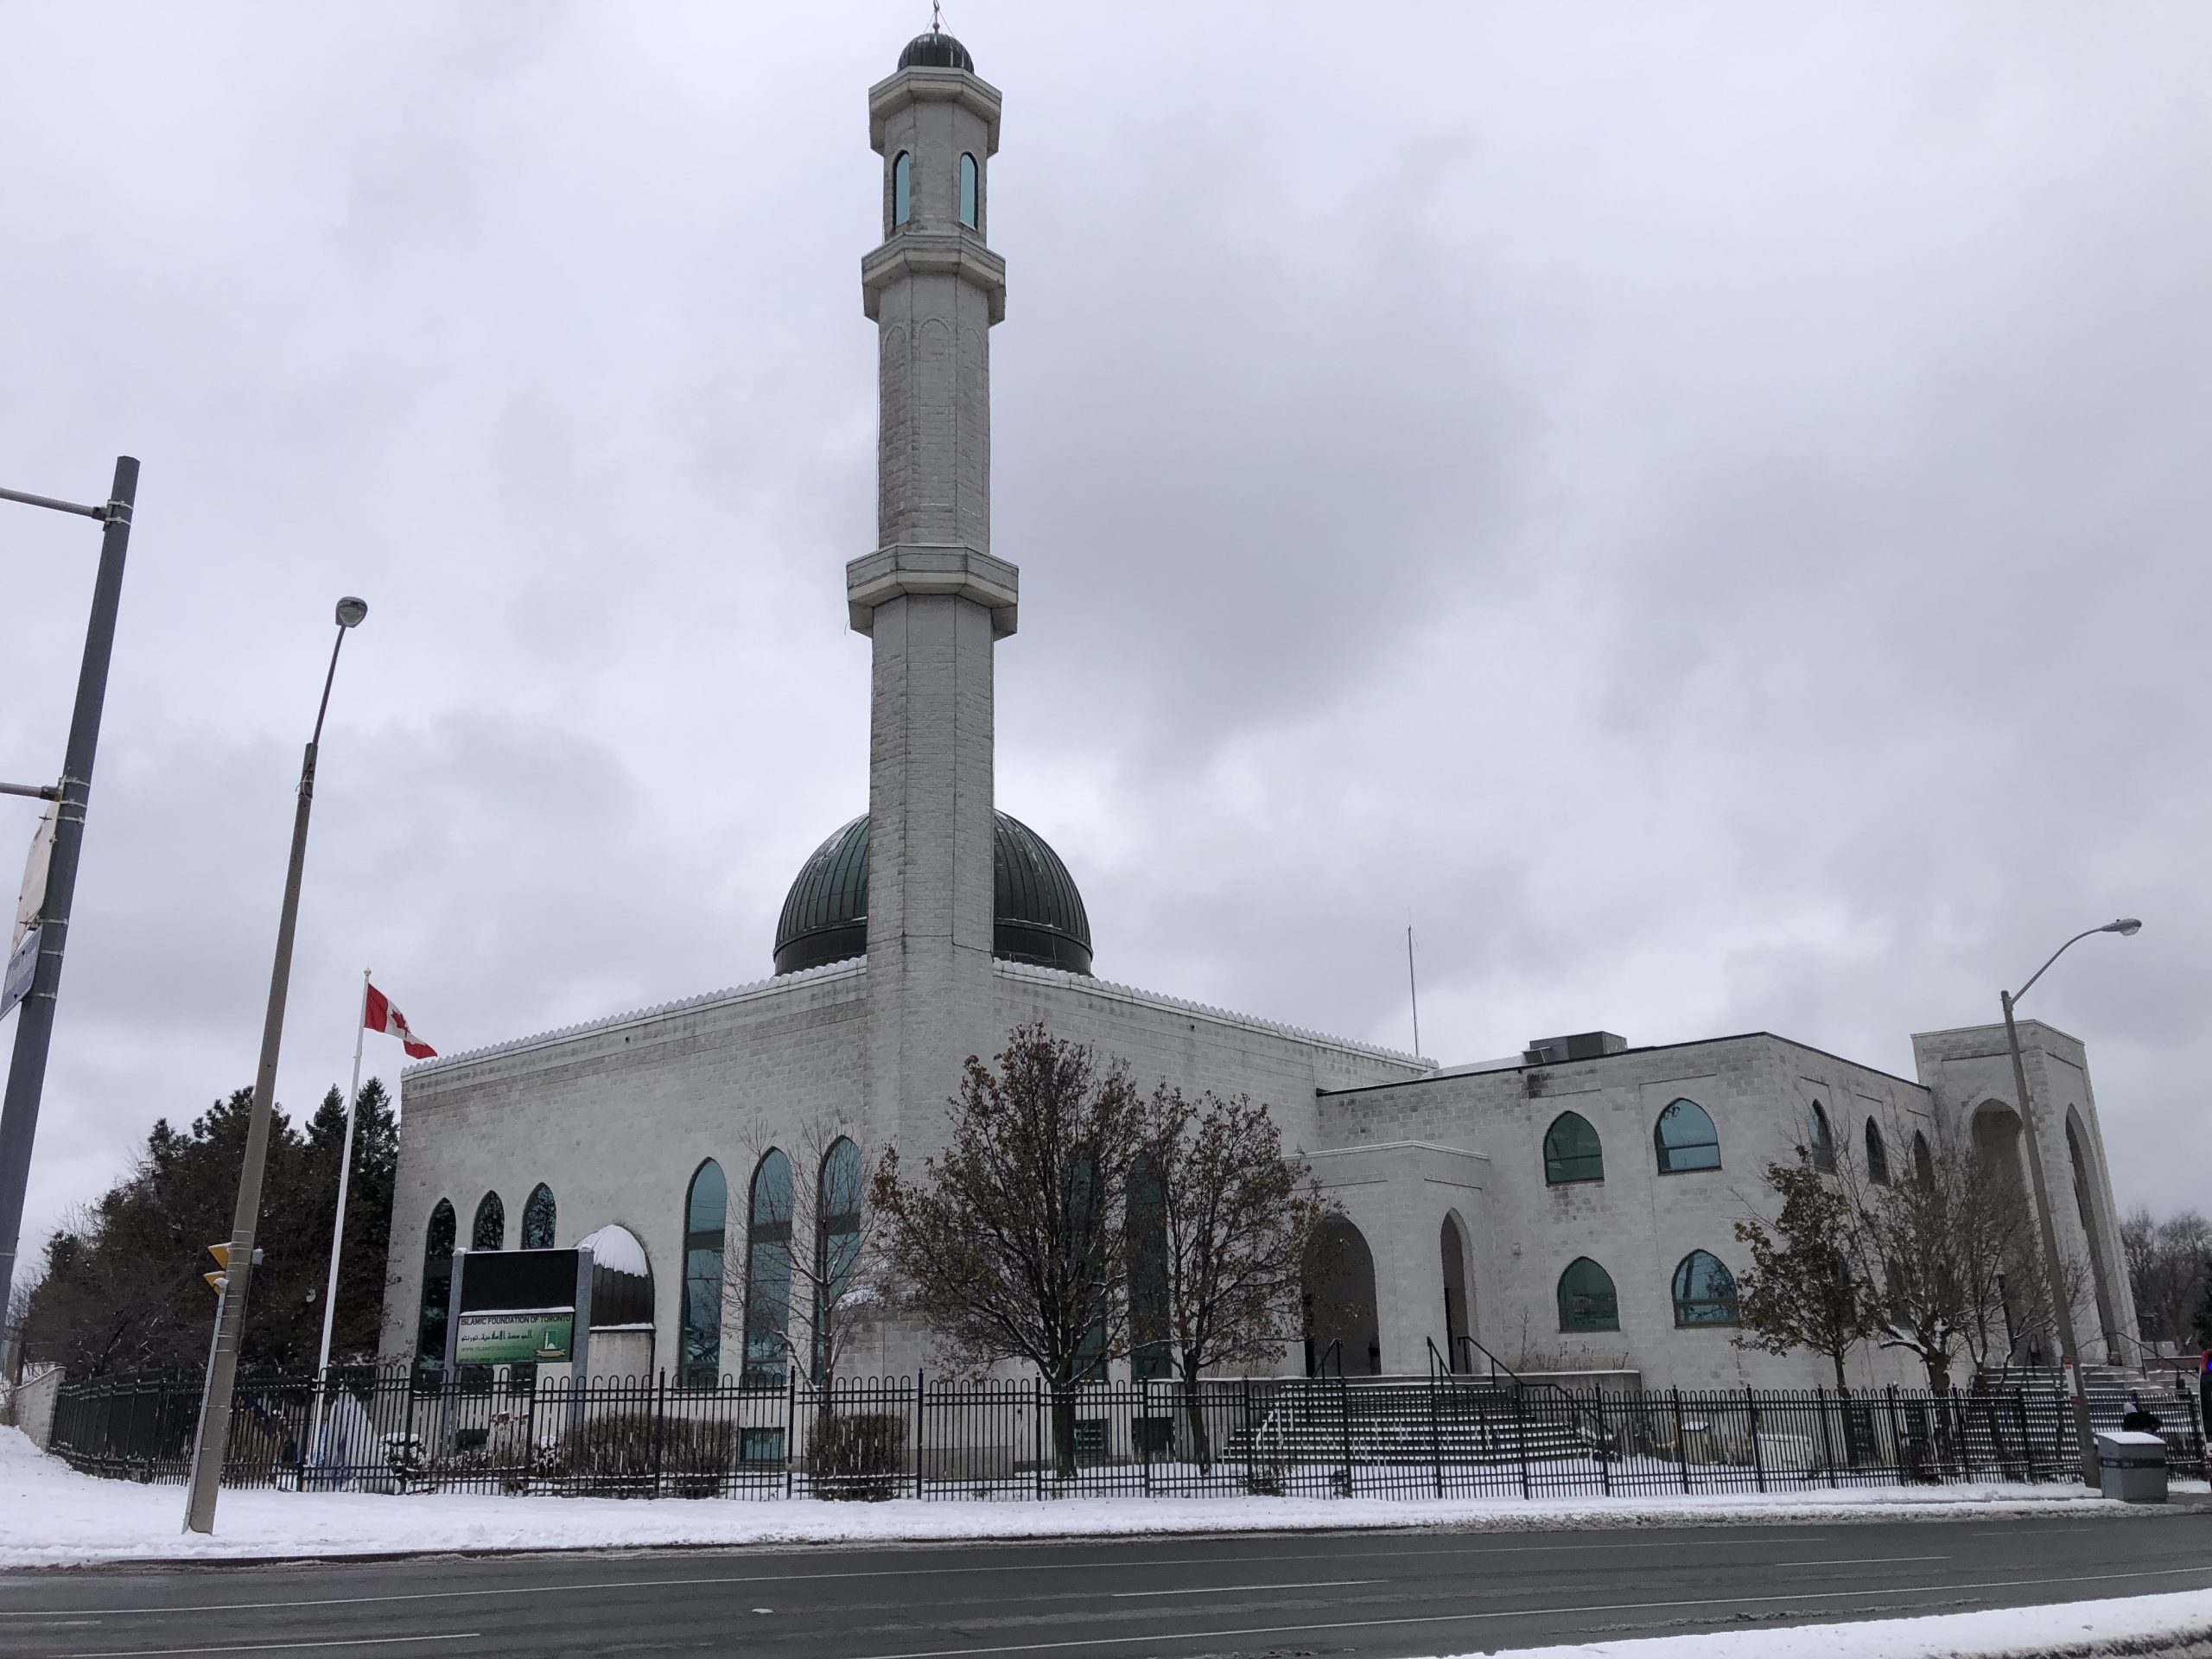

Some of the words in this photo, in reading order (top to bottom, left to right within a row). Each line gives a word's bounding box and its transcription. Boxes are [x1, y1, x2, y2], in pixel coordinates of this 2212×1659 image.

[461, 1317, 486, 1325] ISLAMIC
[487, 1315, 530, 1325] FOUNDATION
[530, 1315, 539, 1324] OF
[541, 1313, 571, 1323] TORONTO
